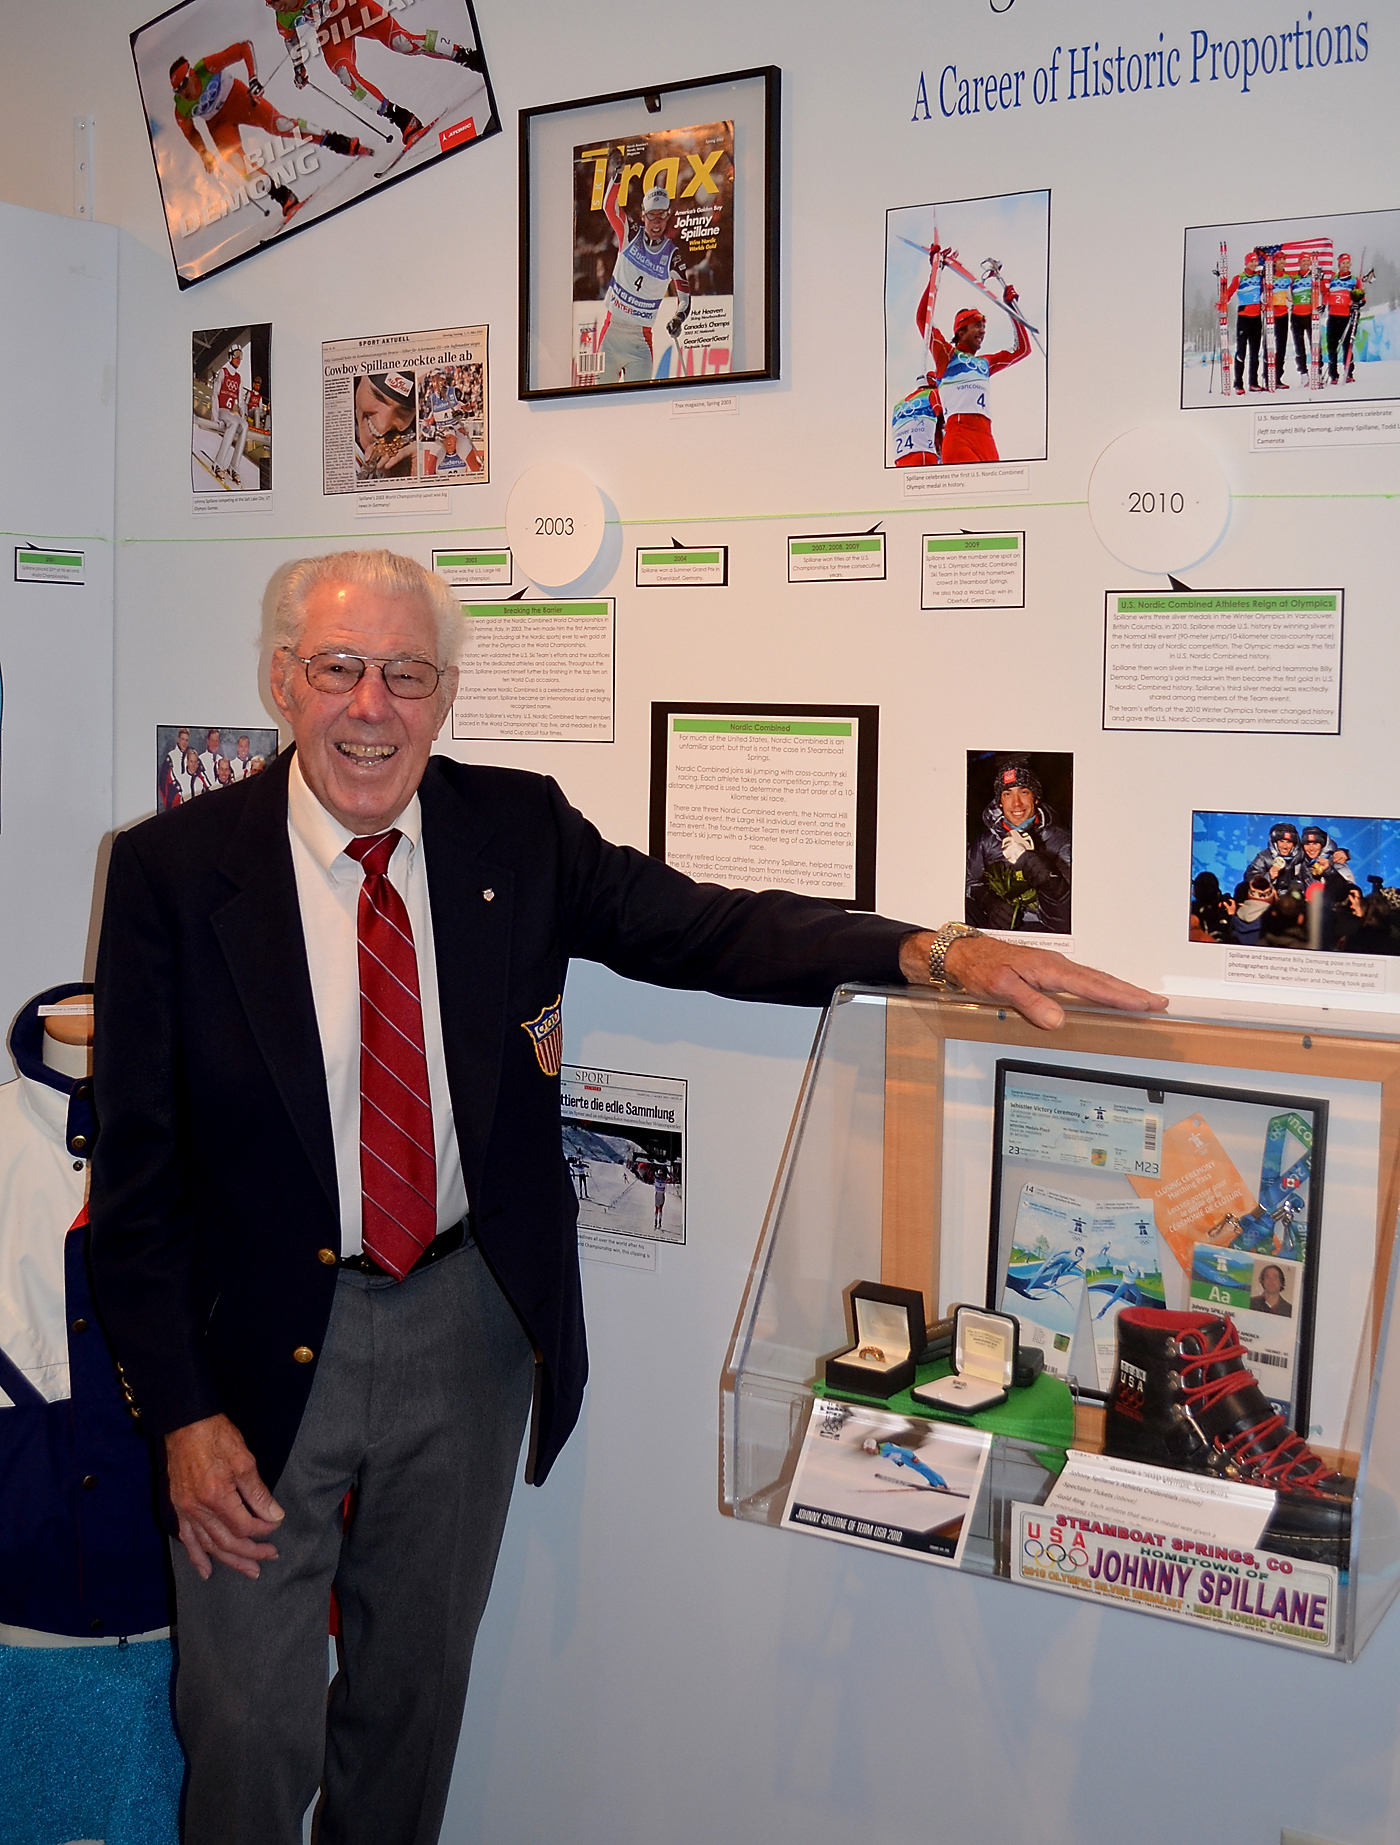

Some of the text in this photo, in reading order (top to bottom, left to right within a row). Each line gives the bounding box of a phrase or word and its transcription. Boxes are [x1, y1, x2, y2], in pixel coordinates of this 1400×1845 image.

[911, 10, 1369, 121] A Career of Historic Proportions
[448, 123, 471, 138] ATOMIC
[243, 126, 313, 175] BILL
[581, 145, 725, 211] Trax
[180, 148, 320, 238] DEMONG
[674, 215, 713, 228] Johnny
[680, 226, 720, 241] Spillane
[629, 245, 664, 274] Buderus
[634, 276, 643, 291] 4
[684, 323, 708, 331] Canada's
[359, 336, 410, 347] SPORT AKTUELL
[325, 363, 358, 376] Cowboy
[361, 360, 400, 373] Spillane
[403, 357, 436, 368] zockte
[438, 352, 457, 363] alle
[459, 350, 472, 361] ab
[977, 393, 985, 410] 4
[896, 435, 914, 453] 24
[1128, 492, 1184, 513] 2010
[535, 518, 575, 536] 2003
[504, 607, 530, 615] Breaking
[1215, 600, 1250, 608] Athletes
[1253, 600, 1276, 609] Reign
[1290, 600, 1332, 609] Olympics
[754, 724, 791, 732] Combined
[793, 737, 828, 745] Combined
[575, 1071, 612, 1084] SPORT
[561, 1094, 674, 1123] ttierte die edle Sammlung
[1010, 1102, 1080, 1118] Whistler Victory Ceremony
[1008, 1145, 1020, 1155] 23
[1135, 1160, 1159, 1174] M23
[1155, 1160, 1215, 1198] CLOSING CEREMONY
[1167, 1173, 1212, 1200] Marching Pass
[1026, 1185, 1034, 1193] 14
[1205, 1204, 1214, 1214] DE
[1209, 1286, 1231, 1303] Aa
[1192, 1303, 1235, 1318] Johnny SPILLANE
[1120, 1371, 1143, 1392] USA
[1069, 1470, 1179, 1501] Johnny Spillane's Athlete Credentials
[1093, 1488, 1113, 1499] Tickets
[795, 1508, 821, 1523] JOHNNY
[821, 1514, 848, 1529] SPILLANE
[847, 1520, 856, 1530] OF
[874, 1526, 887, 1538] USA
[887, 1529, 903, 1542] 2010
[1056, 1514, 1293, 1574] STEAMBOAT SPRINGS, CO
[1140, 1547, 1269, 1580] HOMETOWN OF
[1088, 1547, 1327, 1630] JOHNNY SPILLANE
[1048, 1571, 1092, 1589] OLYMPIC
[1094, 1580, 1129, 1597] SILVER
[1132, 1588, 1184, 1609] MEDALIST
[1193, 1603, 1223, 1619] MENS
[1226, 1611, 1267, 1628] NORDIC
[1269, 1622, 1328, 1642] COMBINED
